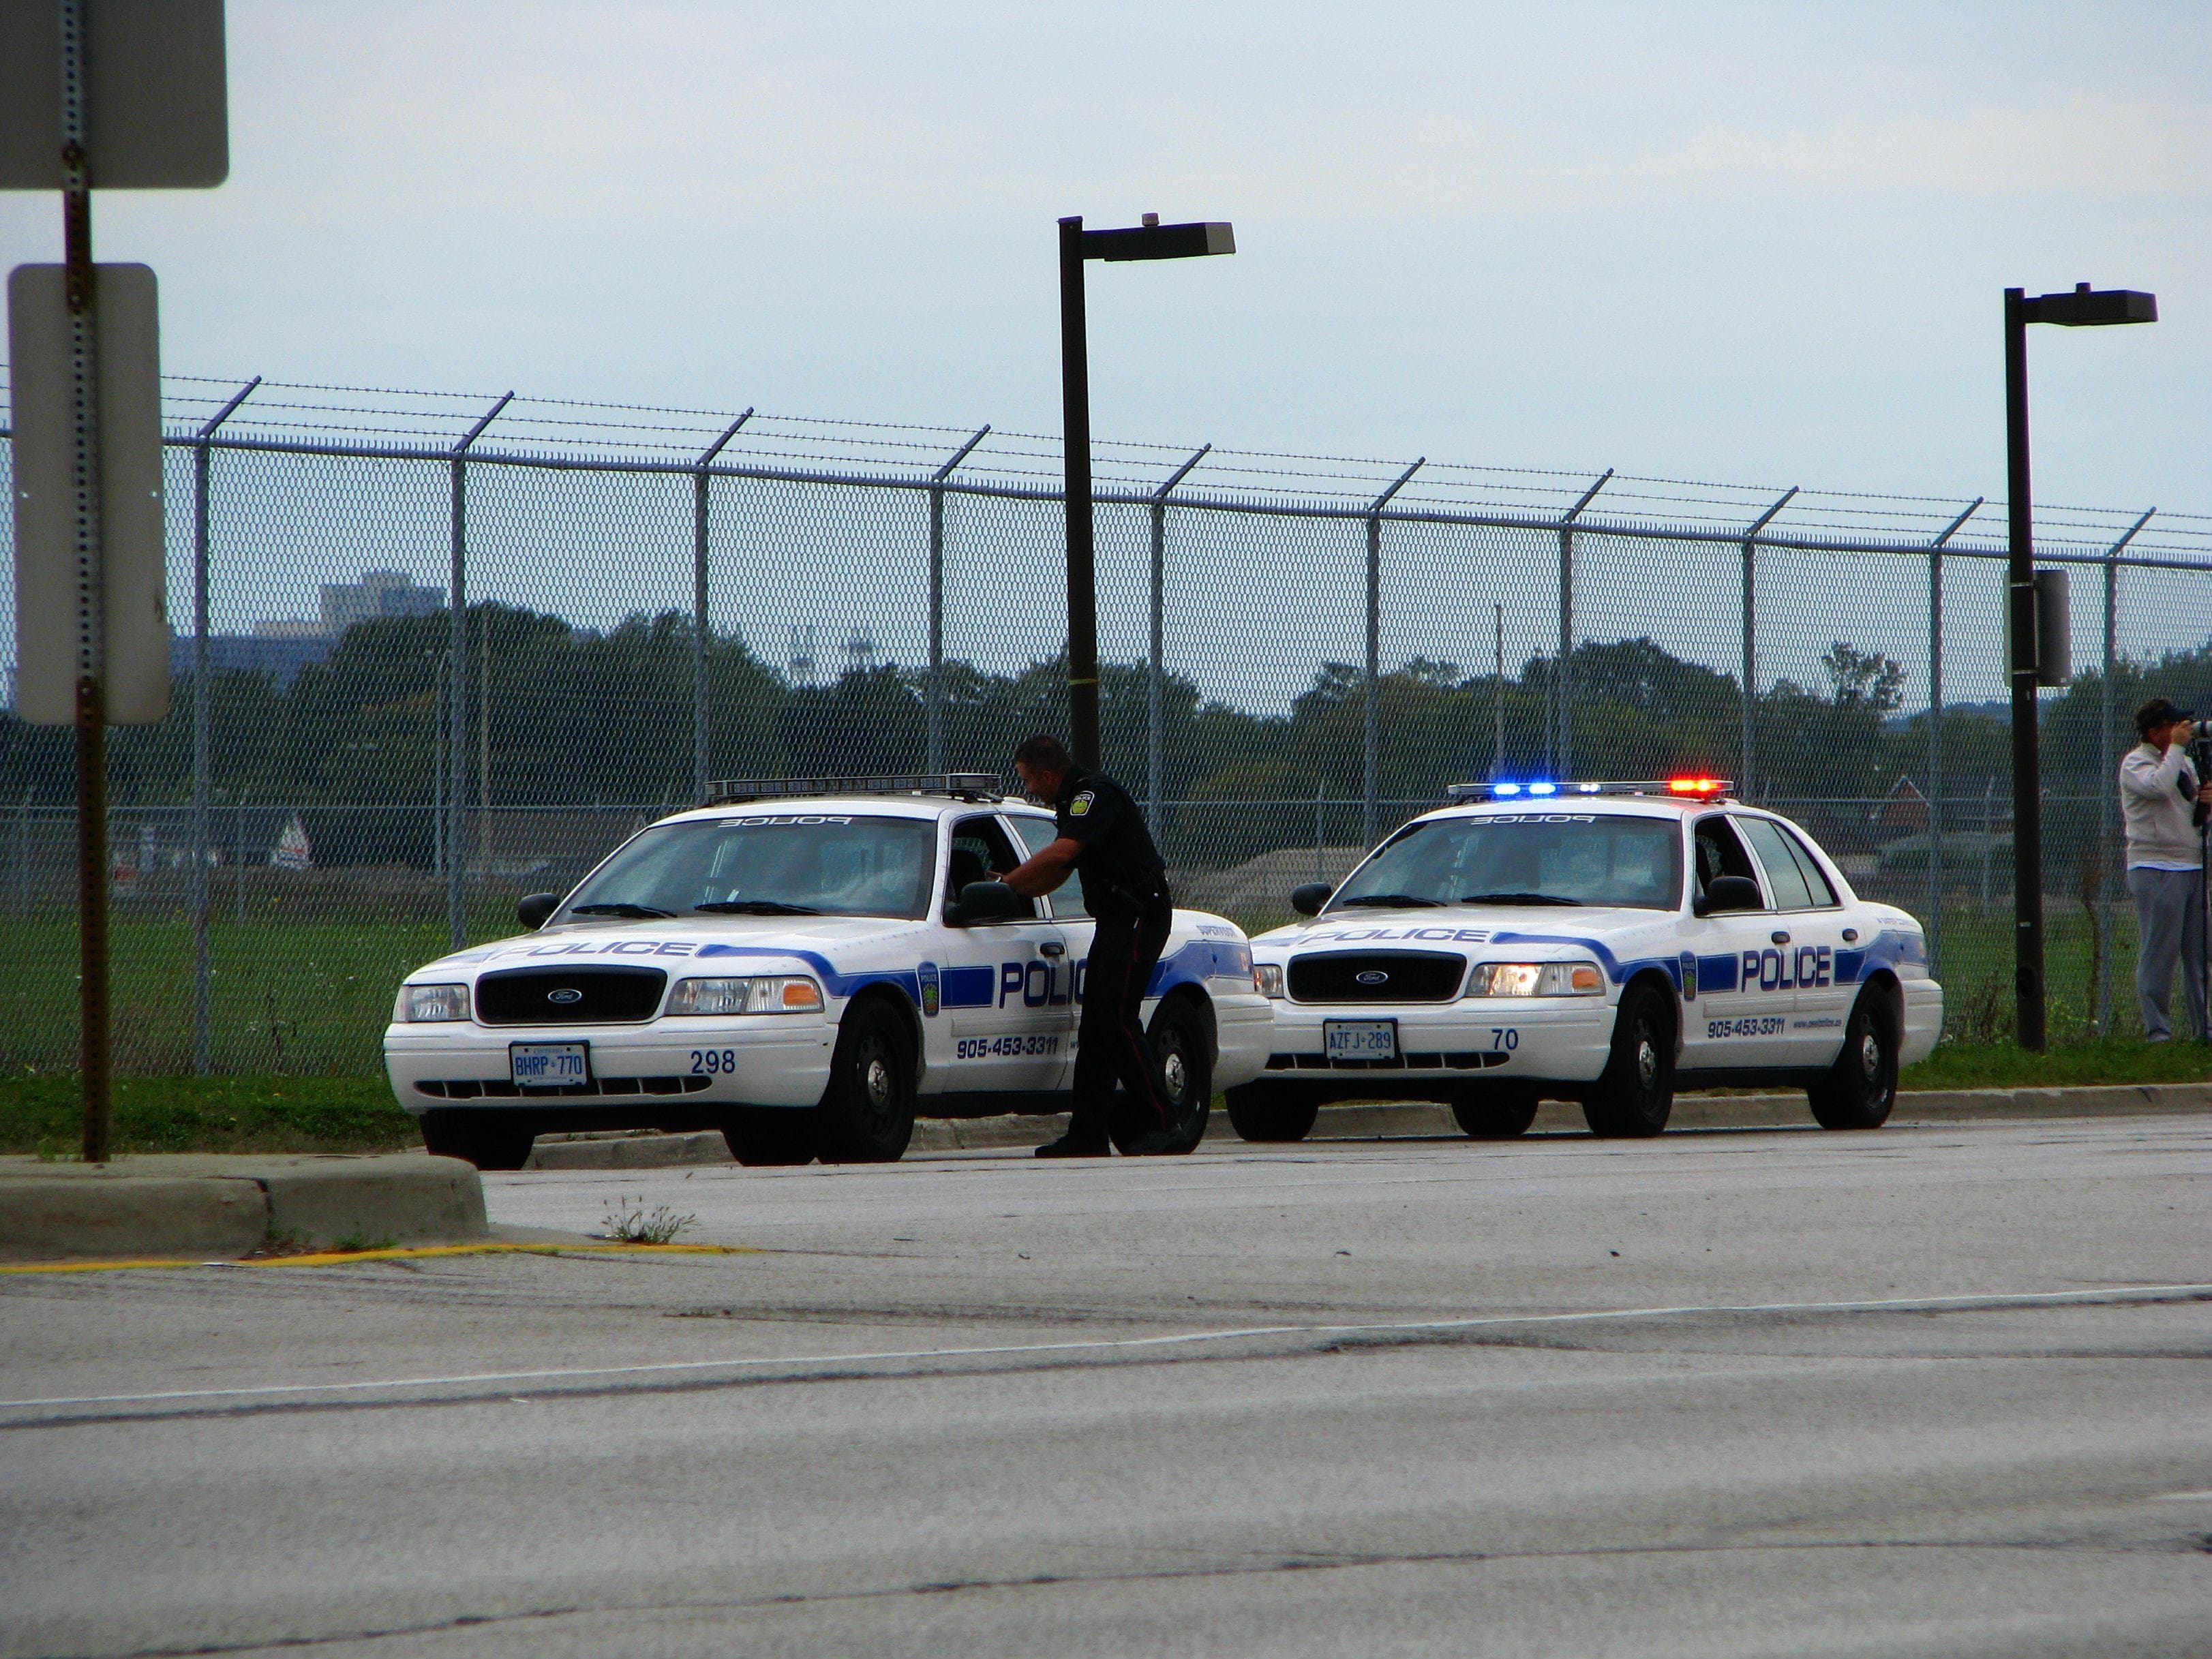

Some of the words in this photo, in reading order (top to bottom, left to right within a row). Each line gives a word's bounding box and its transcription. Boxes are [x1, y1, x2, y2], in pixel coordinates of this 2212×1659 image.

[1297, 928, 1491, 945] POLICE
[487, 941, 698, 962] POLICE
[1742, 945, 1832, 993] POLICE
[999, 958, 1088, 1009] POLIC
[1491, 1029, 1519, 1050] 70
[1708, 1018, 1785, 1039] 905-453-3311
[957, 1036, 1059, 1059] 905-453-3311
[691, 1050, 736, 1074] 298
